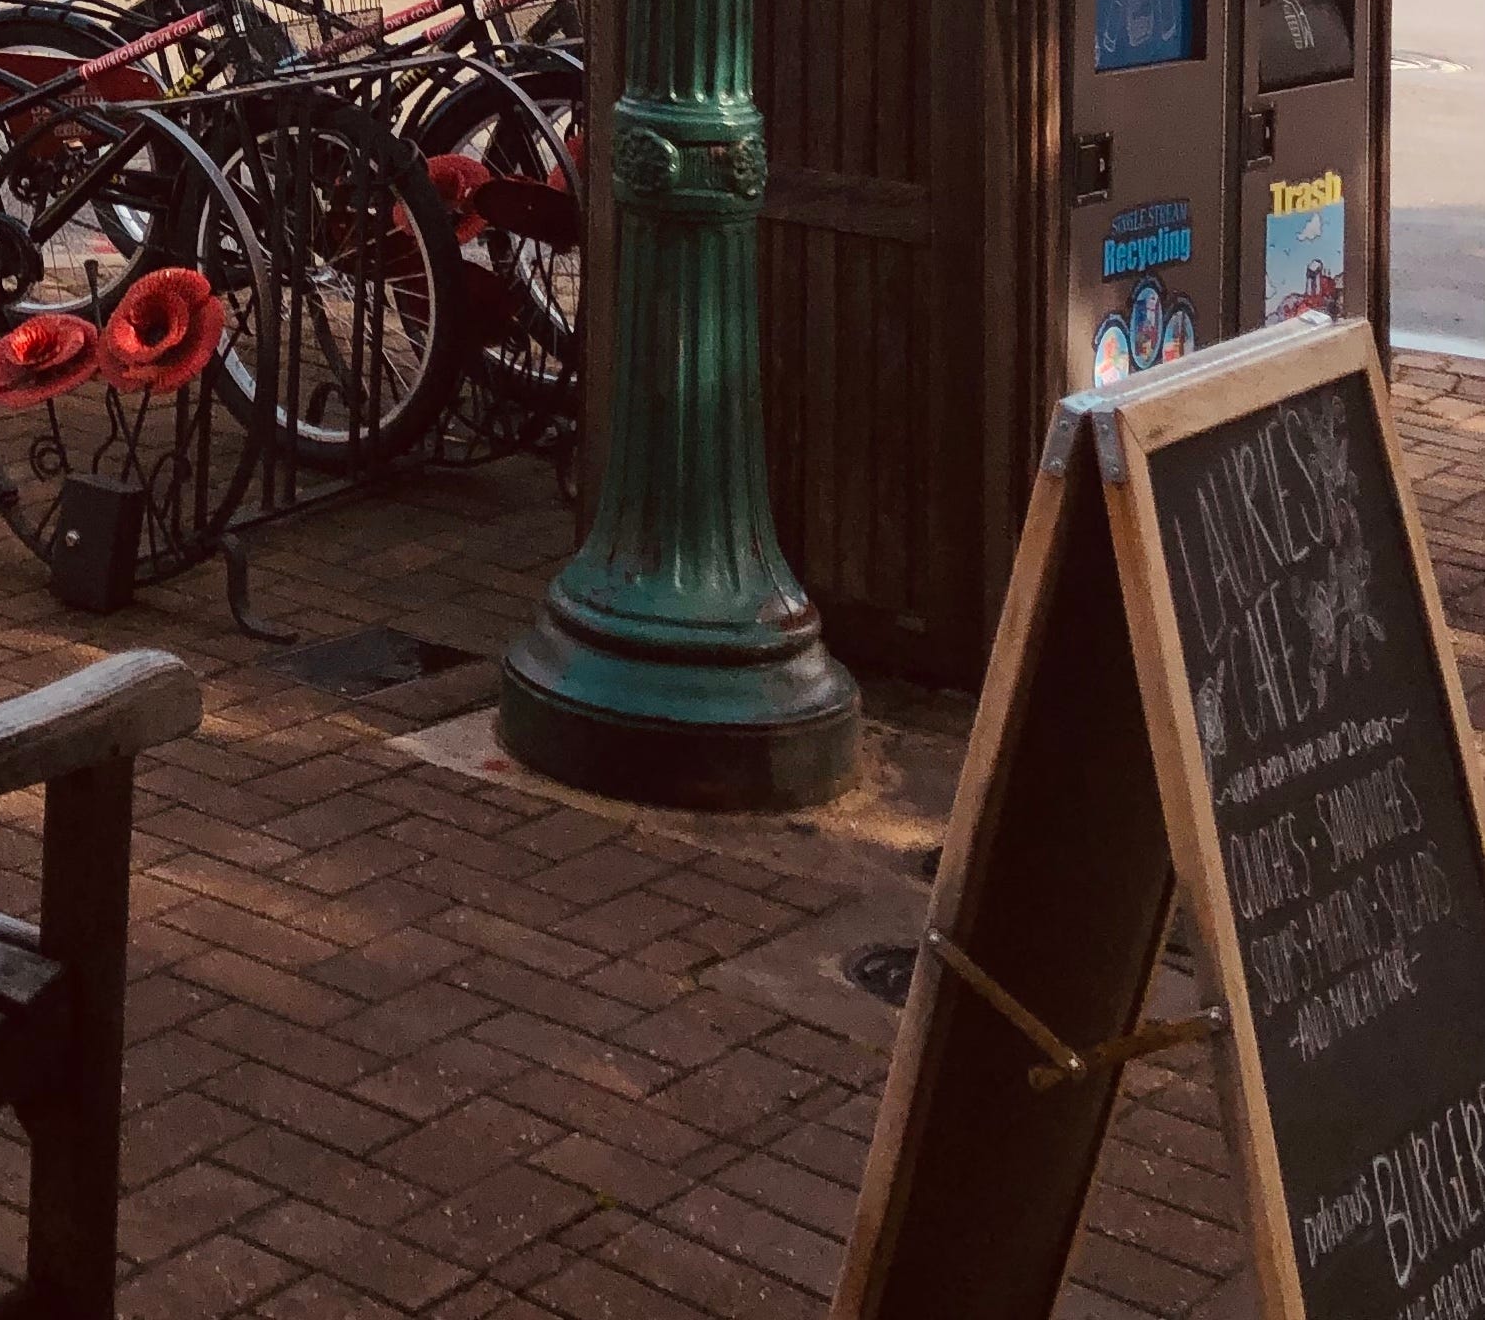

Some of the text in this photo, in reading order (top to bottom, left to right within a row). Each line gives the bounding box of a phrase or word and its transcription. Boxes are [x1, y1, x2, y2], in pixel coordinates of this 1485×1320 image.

[1147, 202, 1188, 228] STREAM
[1269, 171, 1343, 218] Trash
[1103, 226, 1191, 276] Recycling
[1229, 579, 1311, 742] CAFE
[1372, 1083, 1485, 1289] BURGER
